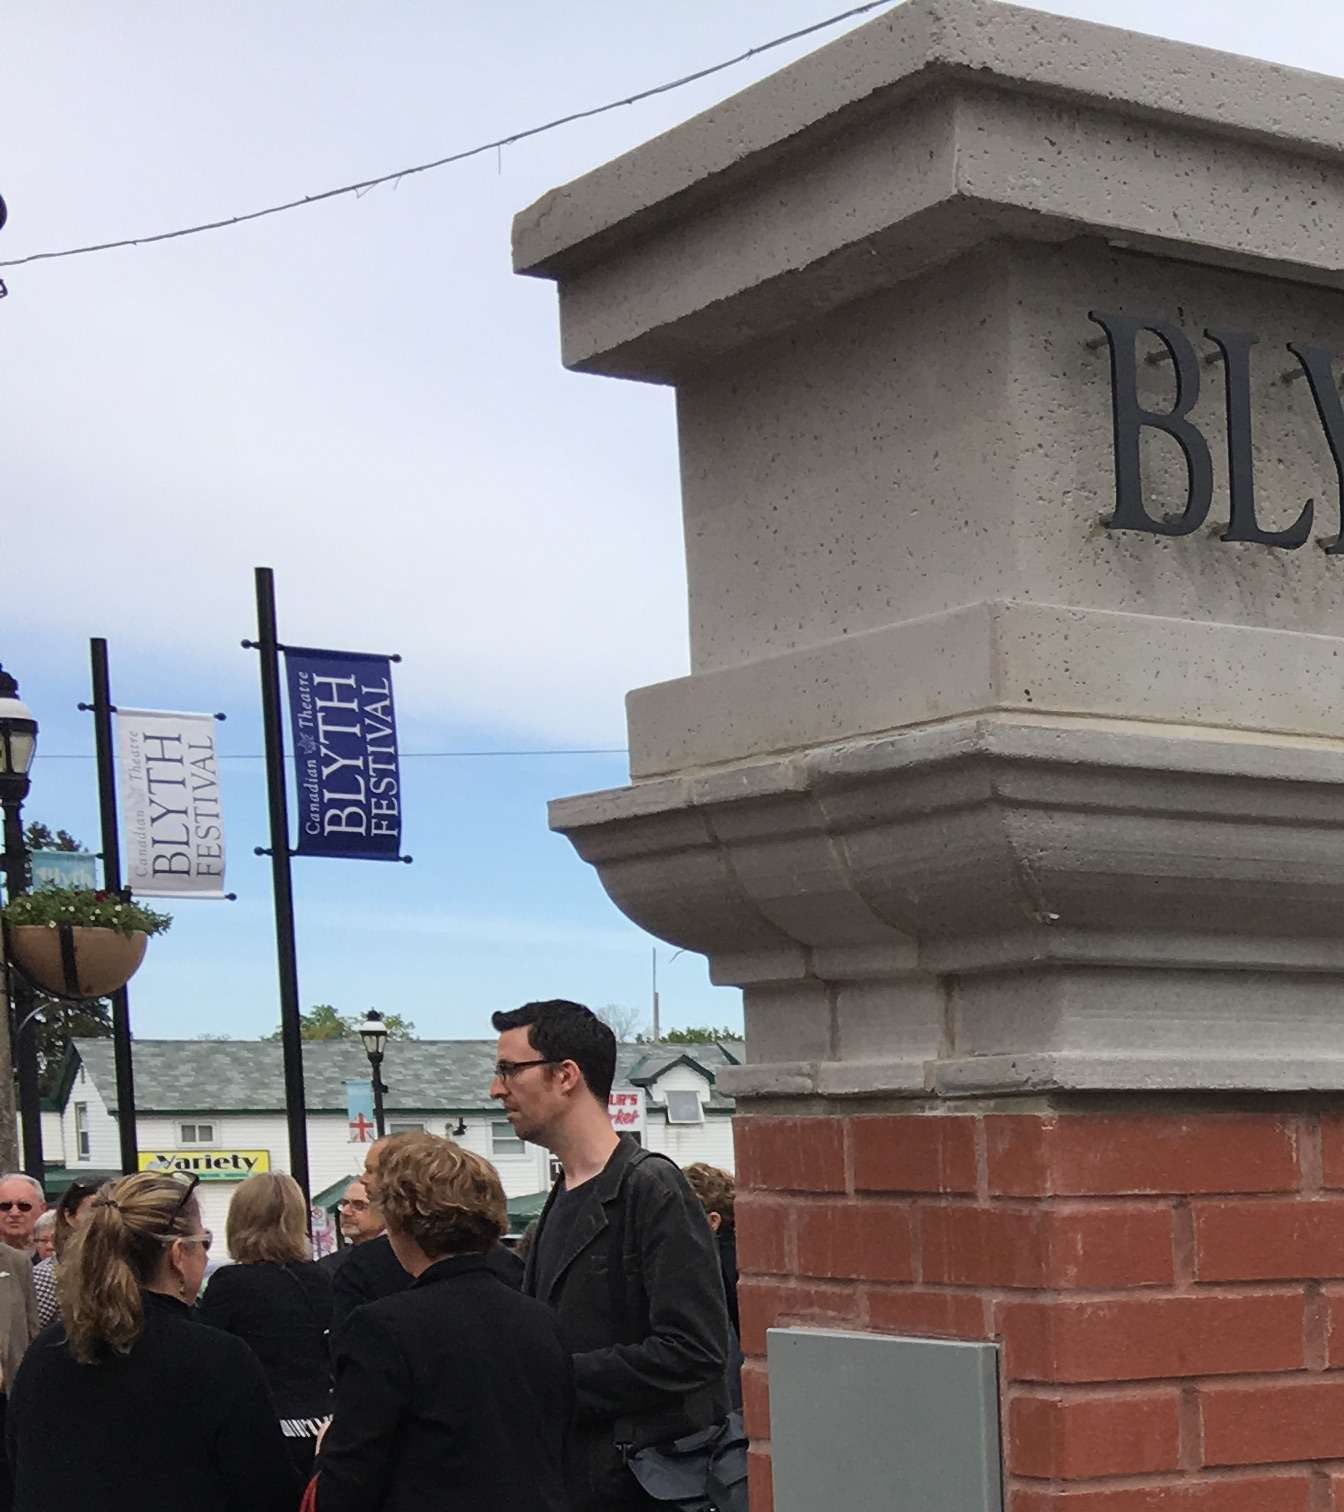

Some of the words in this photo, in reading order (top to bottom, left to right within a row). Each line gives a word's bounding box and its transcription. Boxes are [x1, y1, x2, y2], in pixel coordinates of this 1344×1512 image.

[298, 671, 315, 734] Theatre
[128, 730, 145, 782] Theatre
[312, 672, 367, 837] BLYTH
[360, 677, 399, 837] FESTIVAL
[142, 731, 192, 879] BLYTH
[187, 734, 223, 878] FESTIVAL
[303, 758, 321, 835] Canadian
[134, 809, 147, 878] Canadian
[156, 1154, 258, 1173] Variety
